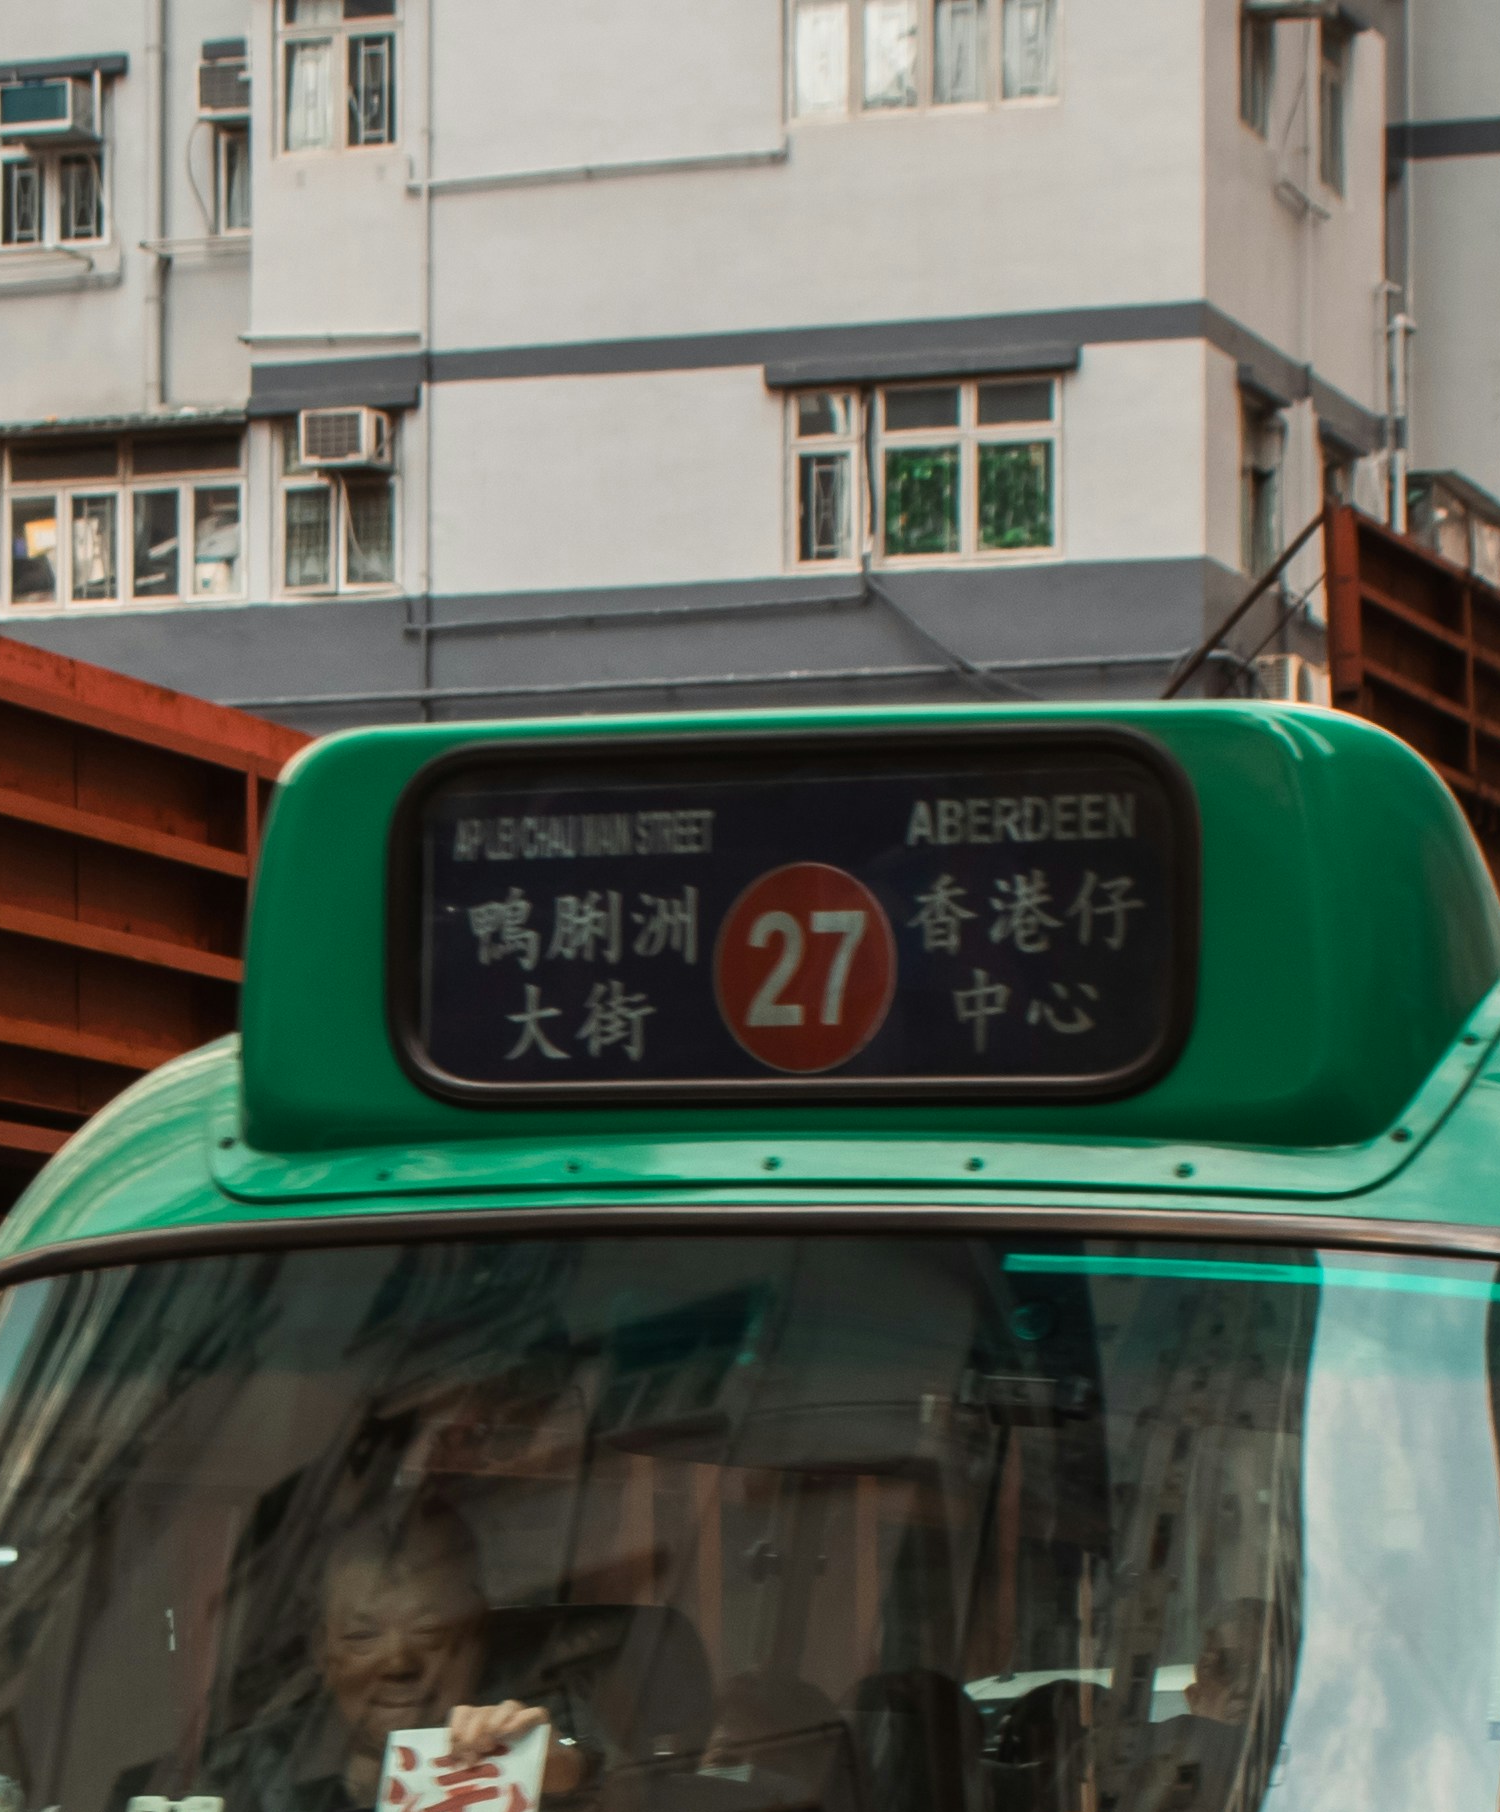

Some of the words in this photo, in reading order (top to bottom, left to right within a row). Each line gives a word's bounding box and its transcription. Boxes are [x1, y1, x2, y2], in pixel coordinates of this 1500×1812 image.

[907, 795, 1136, 847] ABERDEEN
[467, 887, 699, 970] 鴨脷洲
[906, 869, 1146, 954] 香港仔
[745, 909, 867, 1028] 27
[954, 967, 1099, 1053] 中心
[504, 979, 657, 1060] 大街
